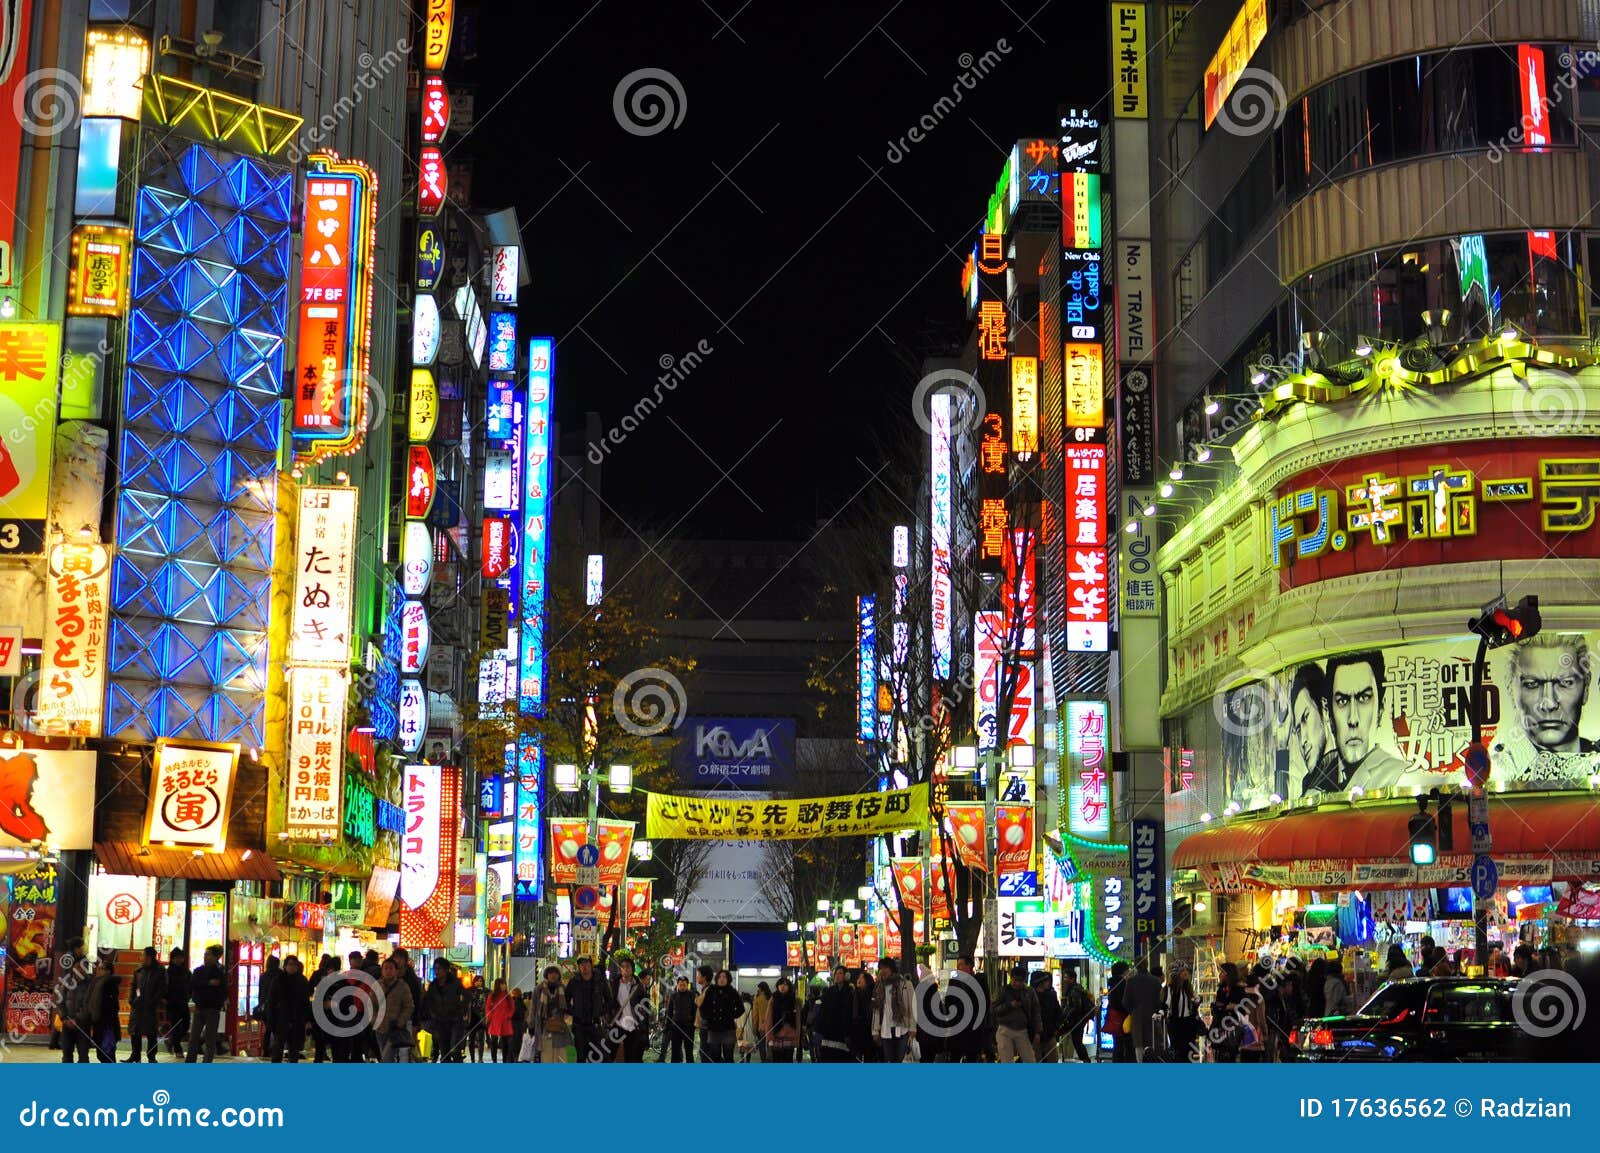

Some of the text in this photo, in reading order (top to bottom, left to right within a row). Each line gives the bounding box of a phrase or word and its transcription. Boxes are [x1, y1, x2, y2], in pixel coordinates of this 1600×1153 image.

[1065, 252, 1100, 260] New Club
[305, 288, 322, 300] 7F
[1067, 270, 1082, 323] Elle de
[1084, 262, 1099, 310] Castle
[1127, 245, 1143, 357] No.1 TRAVEL
[1075, 428, 1096, 441] 6F
[0, 523, 20, 549] 3
[303, 546, 332, 648] たぬき
[1126, 580, 1154, 597] 植毛
[1126, 599, 1155, 611] 相談所
[51, 574, 85, 698] まるとら
[82, 582, 103, 678] 焼肉ホルモン
[1441, 661, 1491, 684] OF TE
[1442, 685, 1501, 728] END
[295, 755, 313, 801] 99円
[313, 741, 332, 802] 炭火焼鳥
[1080, 710, 1107, 824] カラオケ
[162, 769, 219, 793] まるとら
[174, 792, 207, 825] 寅
[297, 806, 336, 821] かっぱ
[407, 775, 425, 854] トラノコ
[517, 744, 538, 880] カラオケ館
[661, 792, 912, 825] ここから先 歌舞伎町
[556, 862, 578, 873] Coca-Co
[598, 862, 622, 873] Coca-Cola
[998, 850, 1030, 862] Coca-Cola
[1136, 825, 1157, 914] カラオケ
[1324, 872, 1346, 885] 5%
[1476, 866, 1488, 893] P
[115, 900, 131, 920] 寅
[1104, 877, 1124, 951] カラオケ
[935, 919, 950, 929] 2F
[1137, 918, 1156, 932] B1
